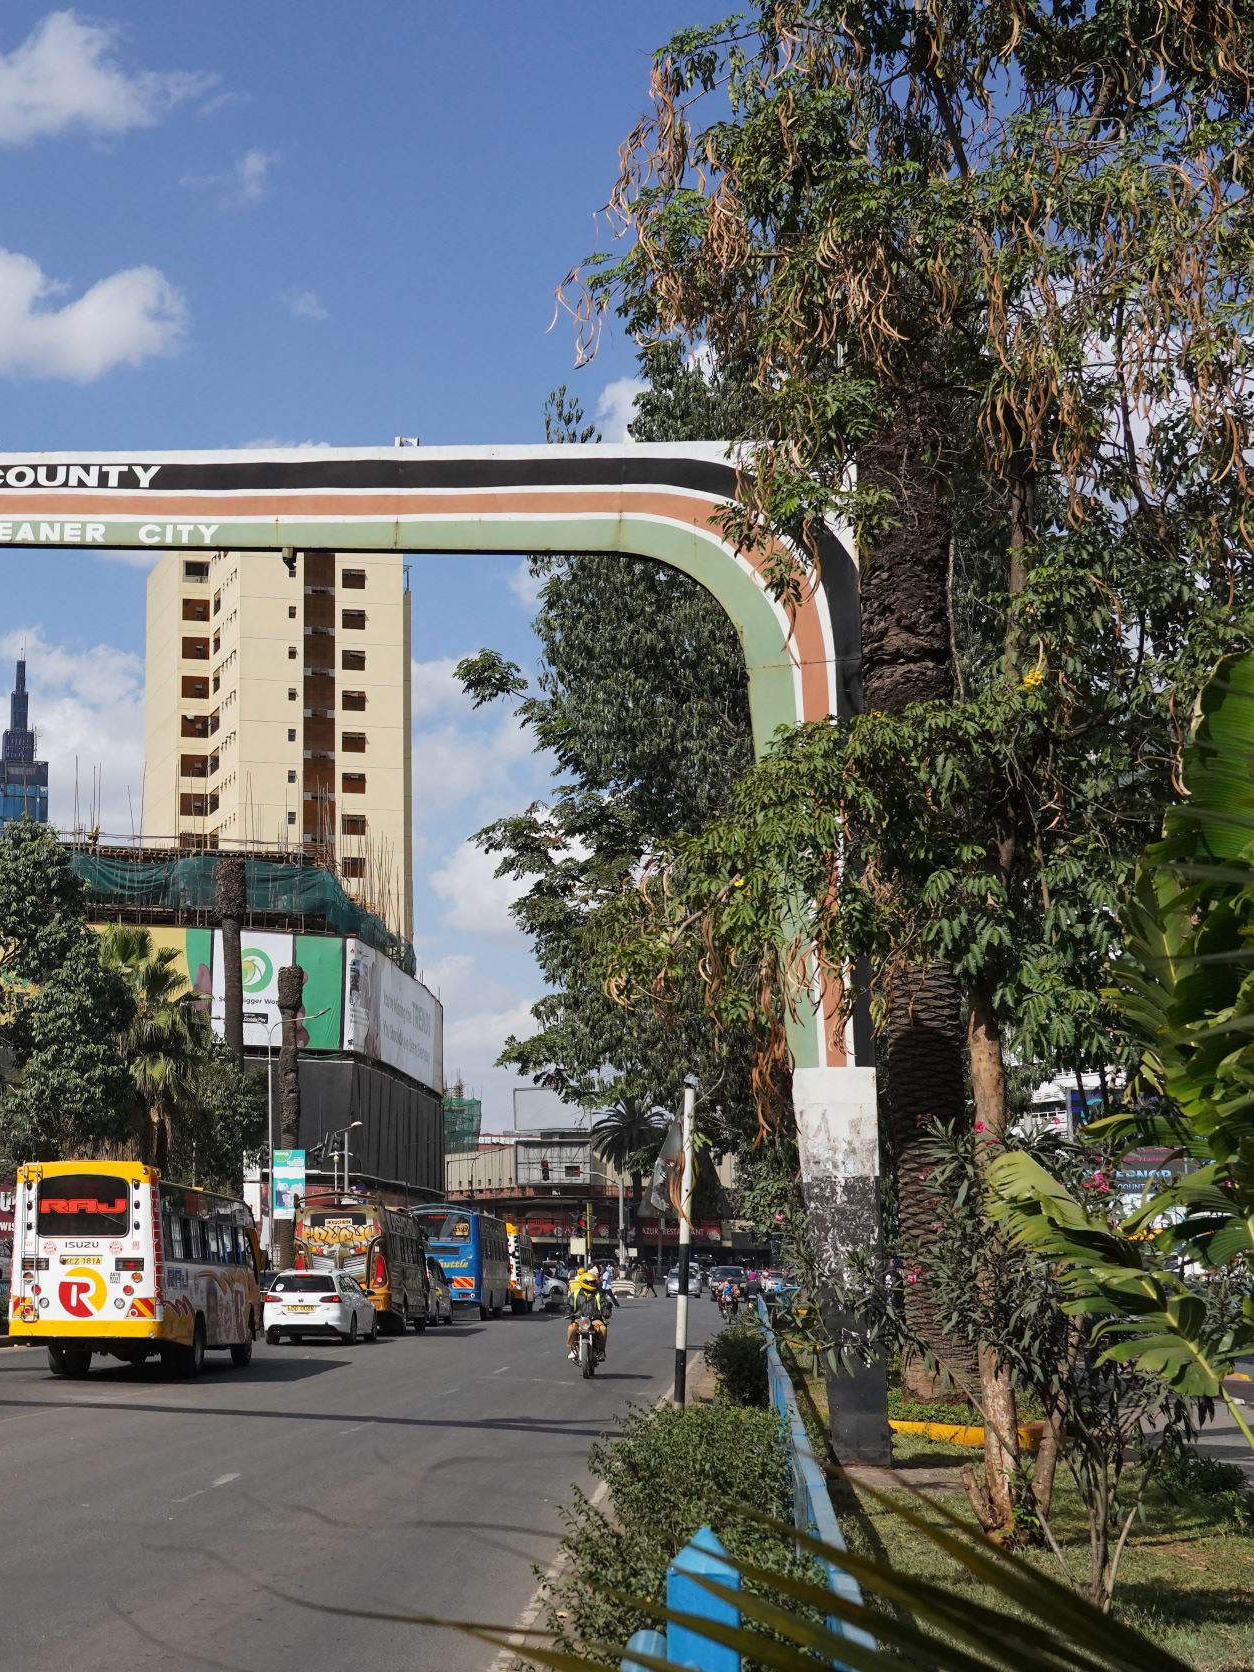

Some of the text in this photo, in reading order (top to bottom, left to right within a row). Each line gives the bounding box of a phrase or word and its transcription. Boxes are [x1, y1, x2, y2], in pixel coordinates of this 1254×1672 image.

[138, 524, 220, 545] CITY
[40, 1198, 128, 1214] RAJ
[65, 1241, 99, 1249] ISUZU
